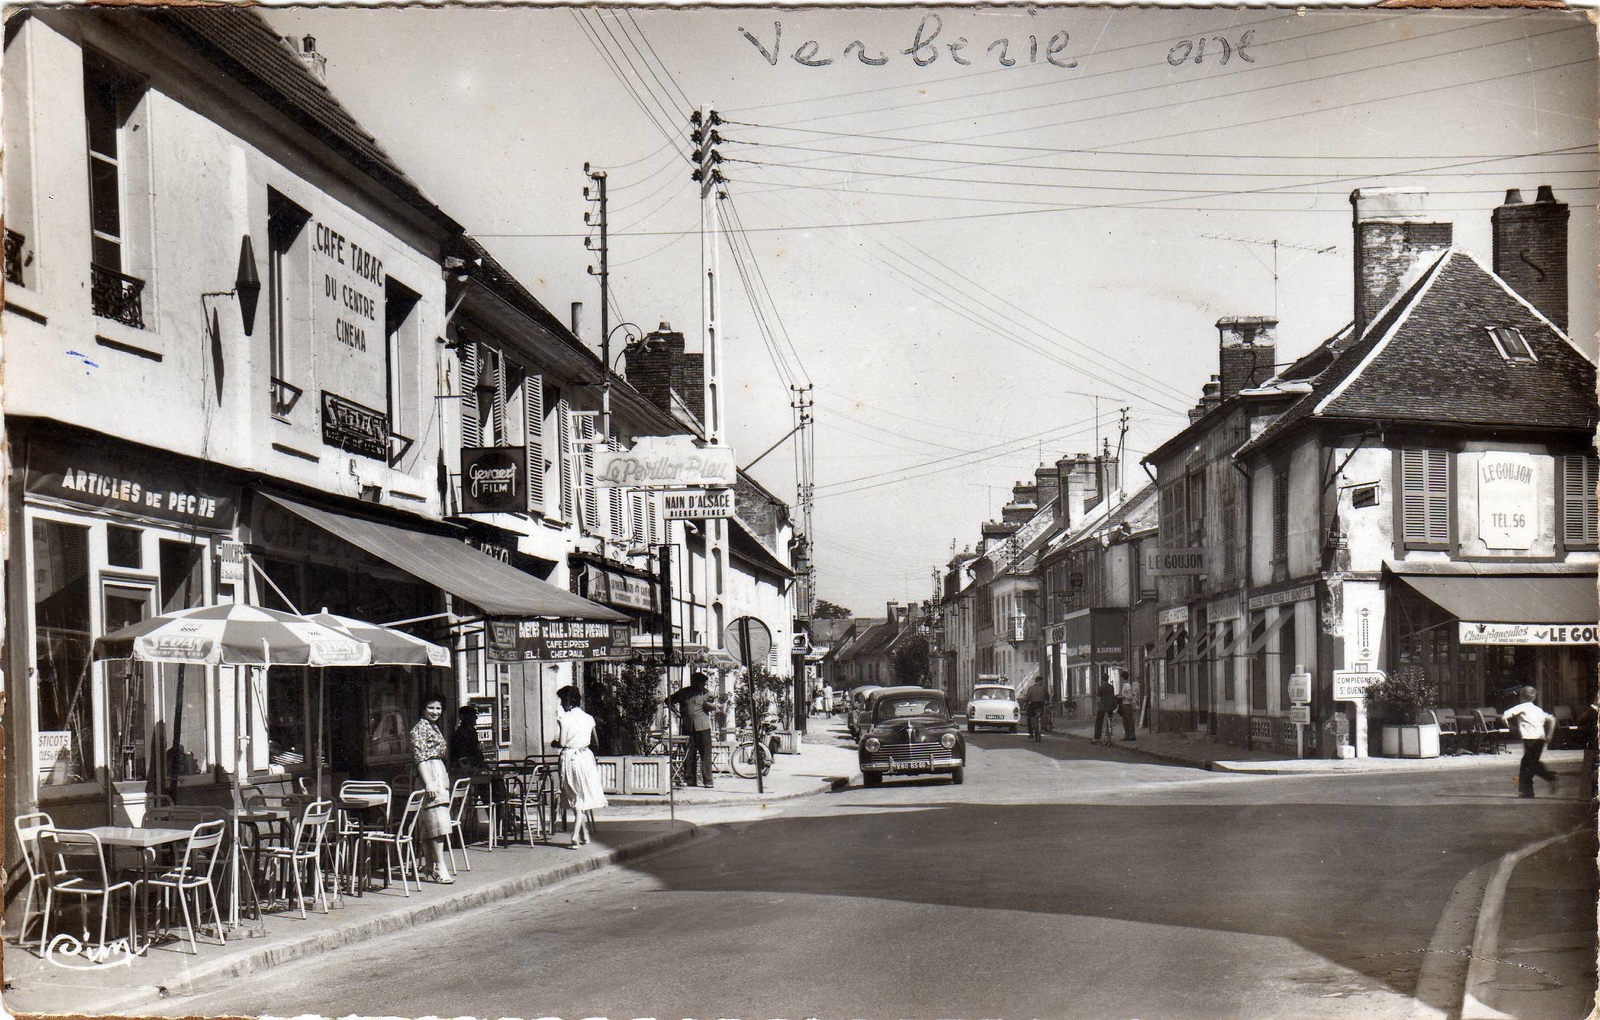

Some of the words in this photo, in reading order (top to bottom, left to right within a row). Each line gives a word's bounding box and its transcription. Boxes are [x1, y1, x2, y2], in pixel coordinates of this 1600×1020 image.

[316, 222, 345, 265] CAFE
[351, 242, 383, 287] TABAC
[325, 273, 337, 301] DU
[342, 284, 375, 321] CENTRE
[336, 318, 366, 353] CINEMA
[469, 462, 518, 498] Gevaert
[1482, 464, 1495, 484] LE
[1496, 462, 1533, 485] GOUJON
[61, 467, 141, 504] ARTICLES
[146, 491, 162, 509] DE
[482, 484, 508, 493] FILM
[665, 494, 686, 509] NAIN
[689, 494, 730, 508] D'ALSACE
[1149, 554, 1161, 570] LE
[1164, 553, 1203, 569] GOUJON
[1549, 627, 1567, 642] LE
[550, 650, 568, 659] CHEZ
[568, 649, 585, 658] PAUL
[1346, 686, 1373, 695] QUENT
[1283, 721, 1297, 741] BERG
